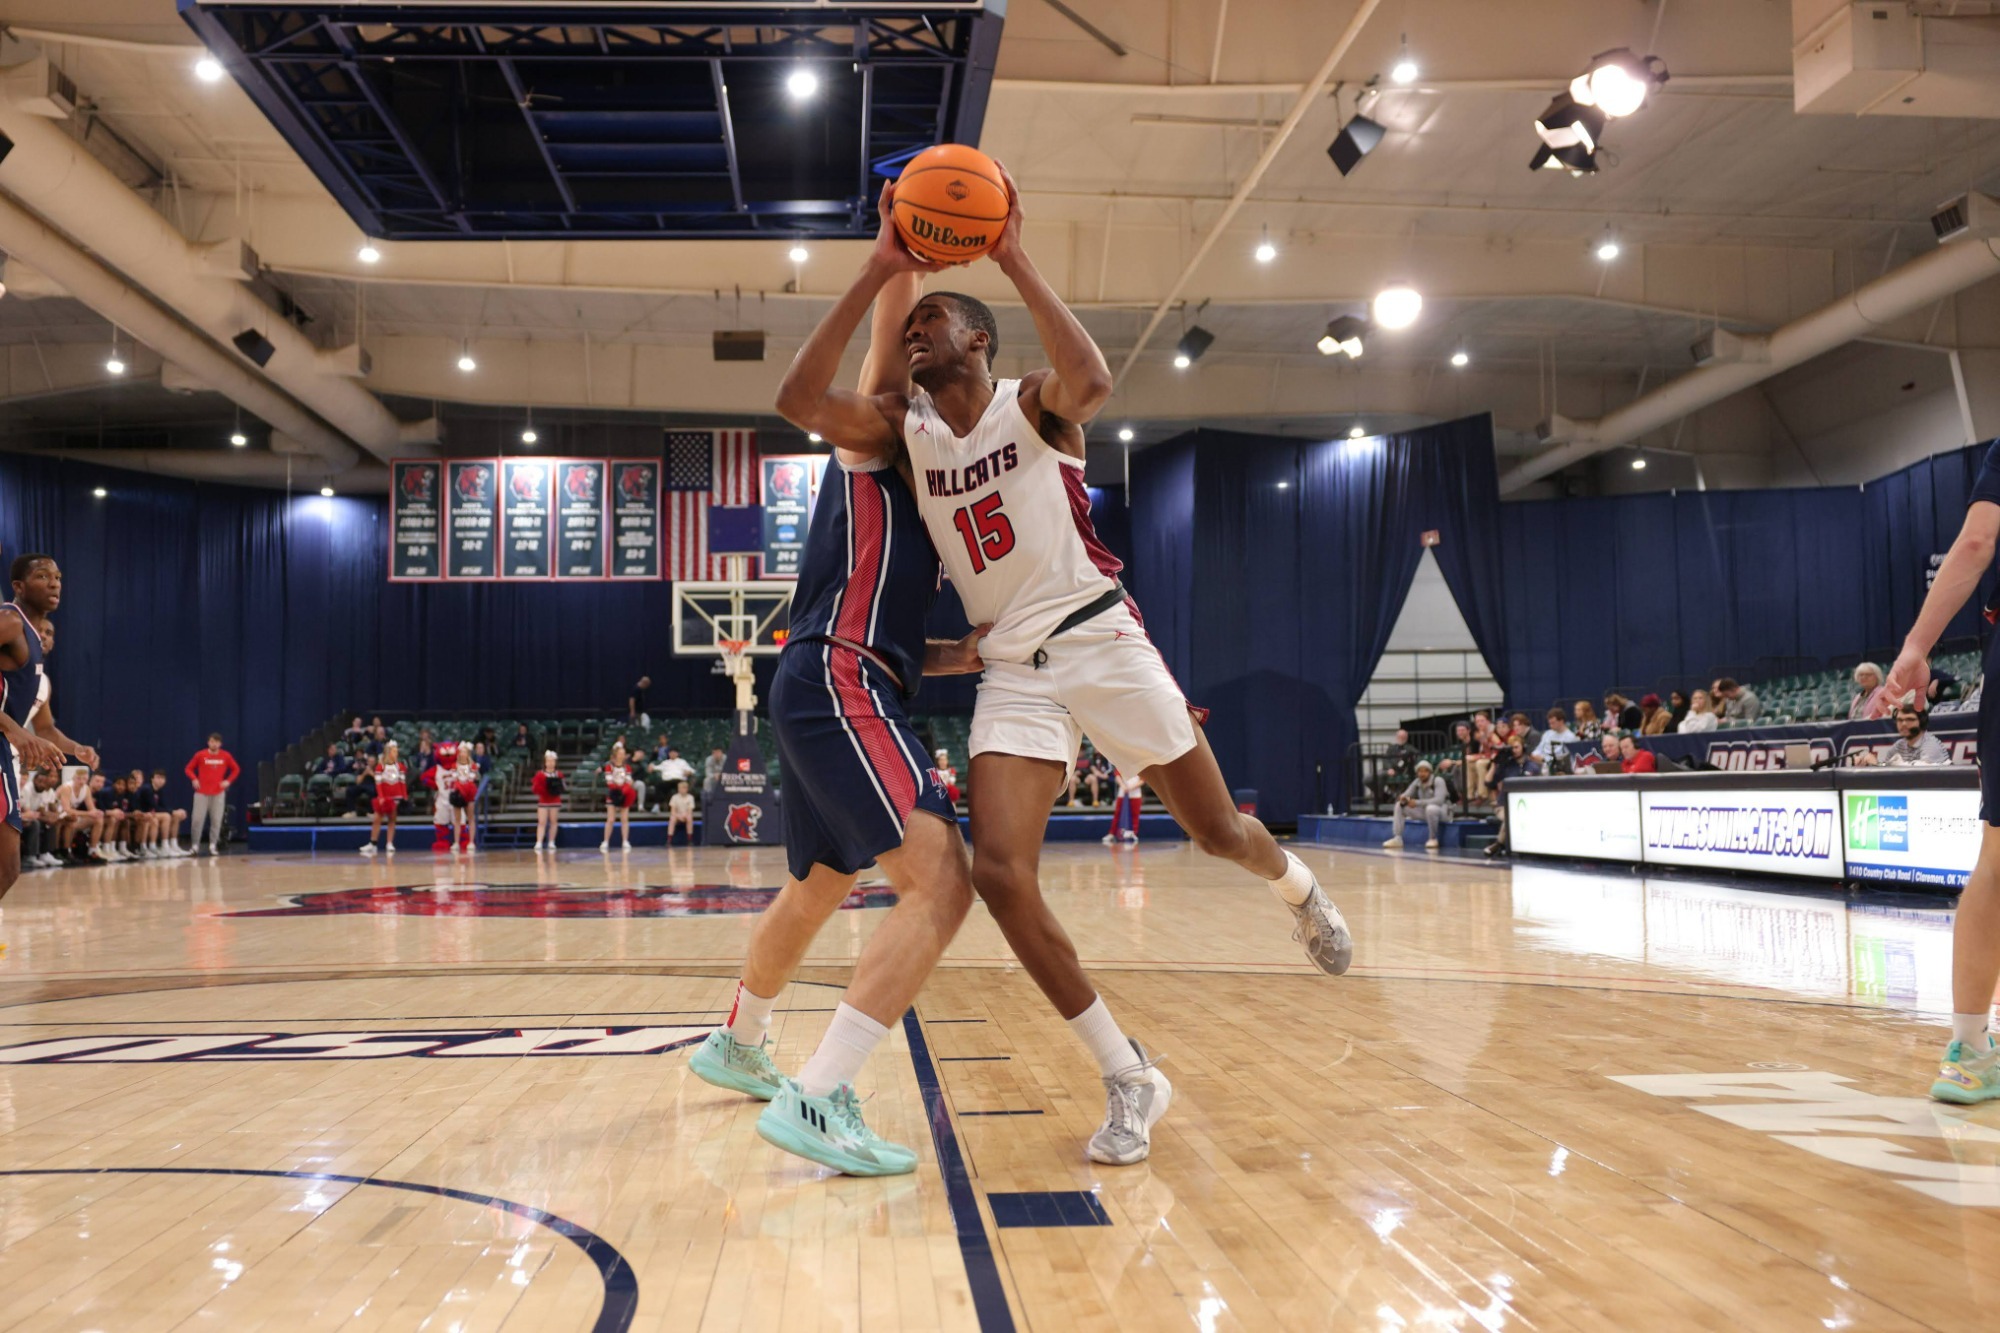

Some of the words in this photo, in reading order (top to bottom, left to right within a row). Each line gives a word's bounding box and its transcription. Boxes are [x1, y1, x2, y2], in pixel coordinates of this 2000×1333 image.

[911, 213, 987, 248] Wilson
[925, 442, 1018, 497] HILLCATS
[953, 490, 1016, 575] 15
[1710, 748, 1830, 771] ROGES
[1649, 806, 1833, 859] WWW.RSUHILLCATS.COM
[1849, 866, 1862, 876] 1410
[1863, 867, 1883, 880] Country
[1884, 868, 1897, 879] Club
[1897, 869, 1911, 881] Road
[1915, 871, 1946, 885] Claremore,
[1947, 874, 1956, 885] OK
